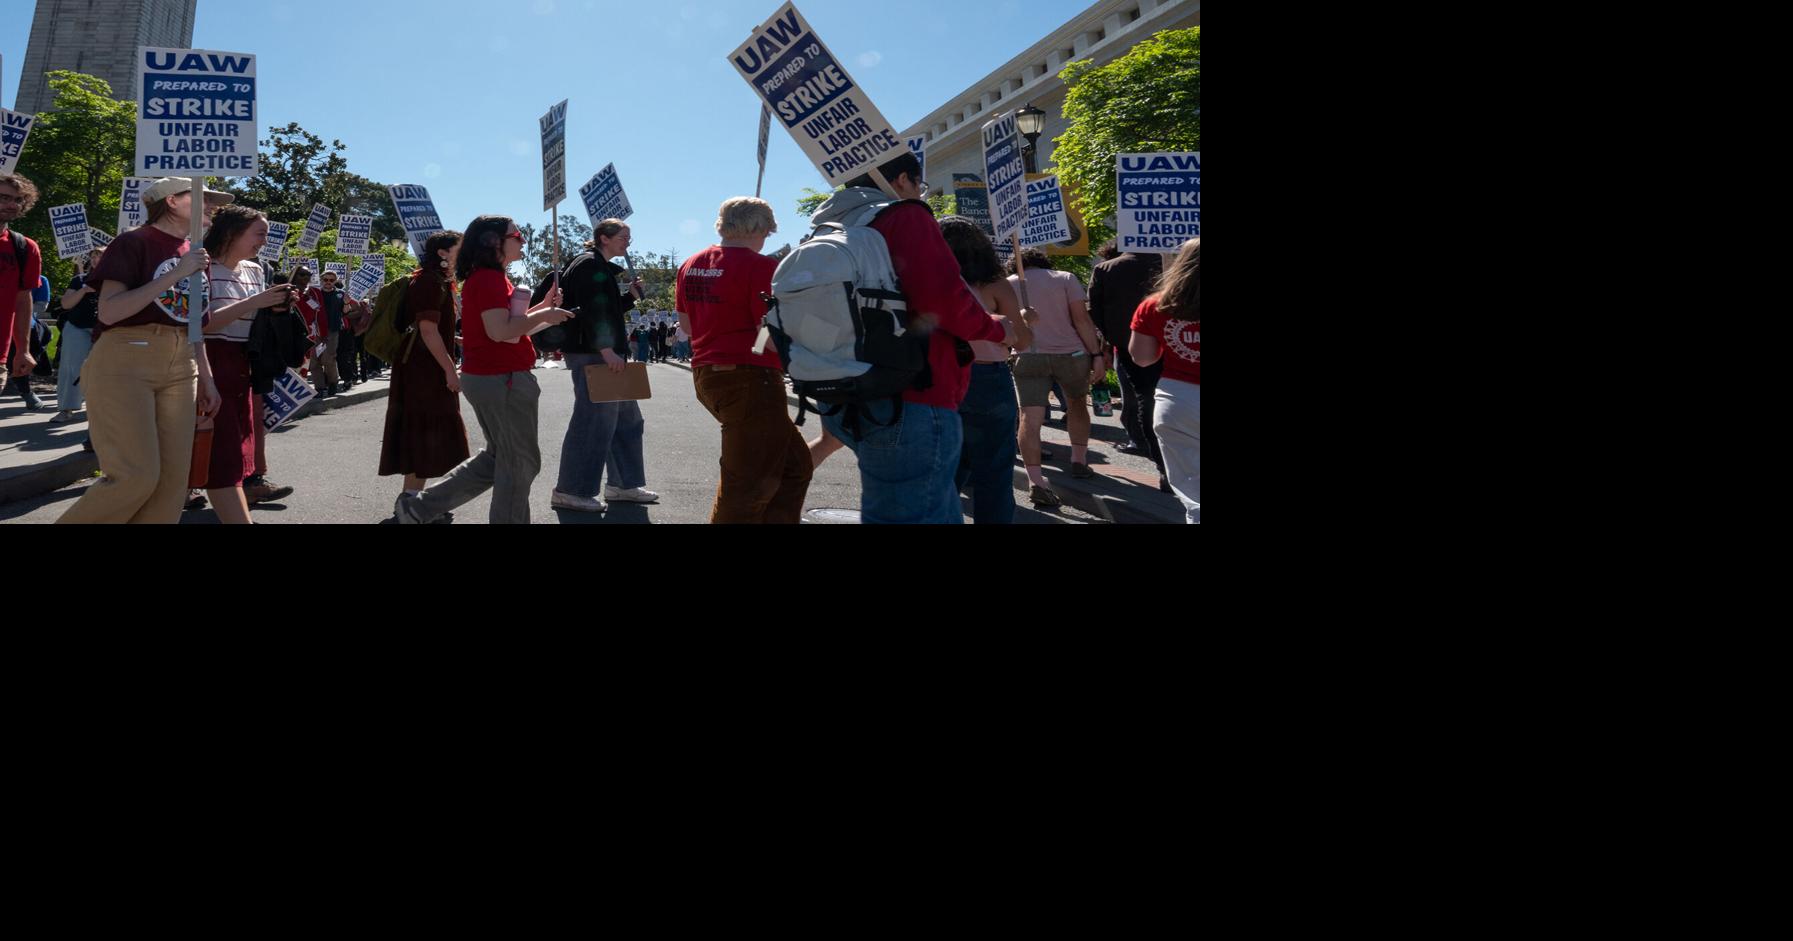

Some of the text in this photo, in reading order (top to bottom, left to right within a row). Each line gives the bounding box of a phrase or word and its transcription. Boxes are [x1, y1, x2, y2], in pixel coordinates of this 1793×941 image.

[735, 7, 802, 74] UAW
[145, 51, 251, 74] UAW
[762, 43, 820, 95] PREPARED TO
[153, 80, 251, 93] PREPARED TO
[776, 64, 847, 121] STRIKE
[146, 97, 250, 117] STRIKE
[802, 97, 860, 139] UNFAIR
[11, 132, 24, 140] TO
[159, 122, 239, 137] UNFAIR
[818, 117, 873, 156] LABOR
[984, 115, 1016, 148] UAW
[162, 138, 235, 153] LABOR
[821, 128, 900, 178] PRACTICE
[144, 155, 253, 170] PRACTICE
[1121, 155, 1200, 171] UAW
[581, 165, 612, 196] UAW
[989, 156, 1022, 190] STRIKE
[1026, 177, 1056, 193] AW
[1122, 177, 1184, 185] PREPARED
[391, 187, 427, 199] UAW
[590, 183, 621, 215] STRIKE
[995, 180, 1021, 206] UNFAIR
[1124, 191, 1200, 206] STRIK
[960, 197, 980, 206] The
[999, 194, 1022, 220] LABOR
[1028, 201, 1061, 217] RIKE
[51, 205, 83, 217] UAW
[961, 206, 989, 216] Bancr
[1134, 210, 1200, 223] UNFAIR
[341, 216, 371, 225] UAW
[404, 216, 440, 229] STRIKE
[996, 204, 1028, 237] PRACTICE
[56, 222, 87, 236] STRIKE
[340, 230, 368, 239] STRIKE
[1024, 223, 1057, 237] LABOR
[1138, 223, 1200, 235] LABOR
[1018, 229, 1068, 246] PRACTICE
[1124, 236, 1189, 248] PRACT
[61, 244, 92, 257] PRACTICE
[363, 264, 384, 277] UAW
[1183, 331, 1200, 343] UA
[278, 372, 313, 401] AW
